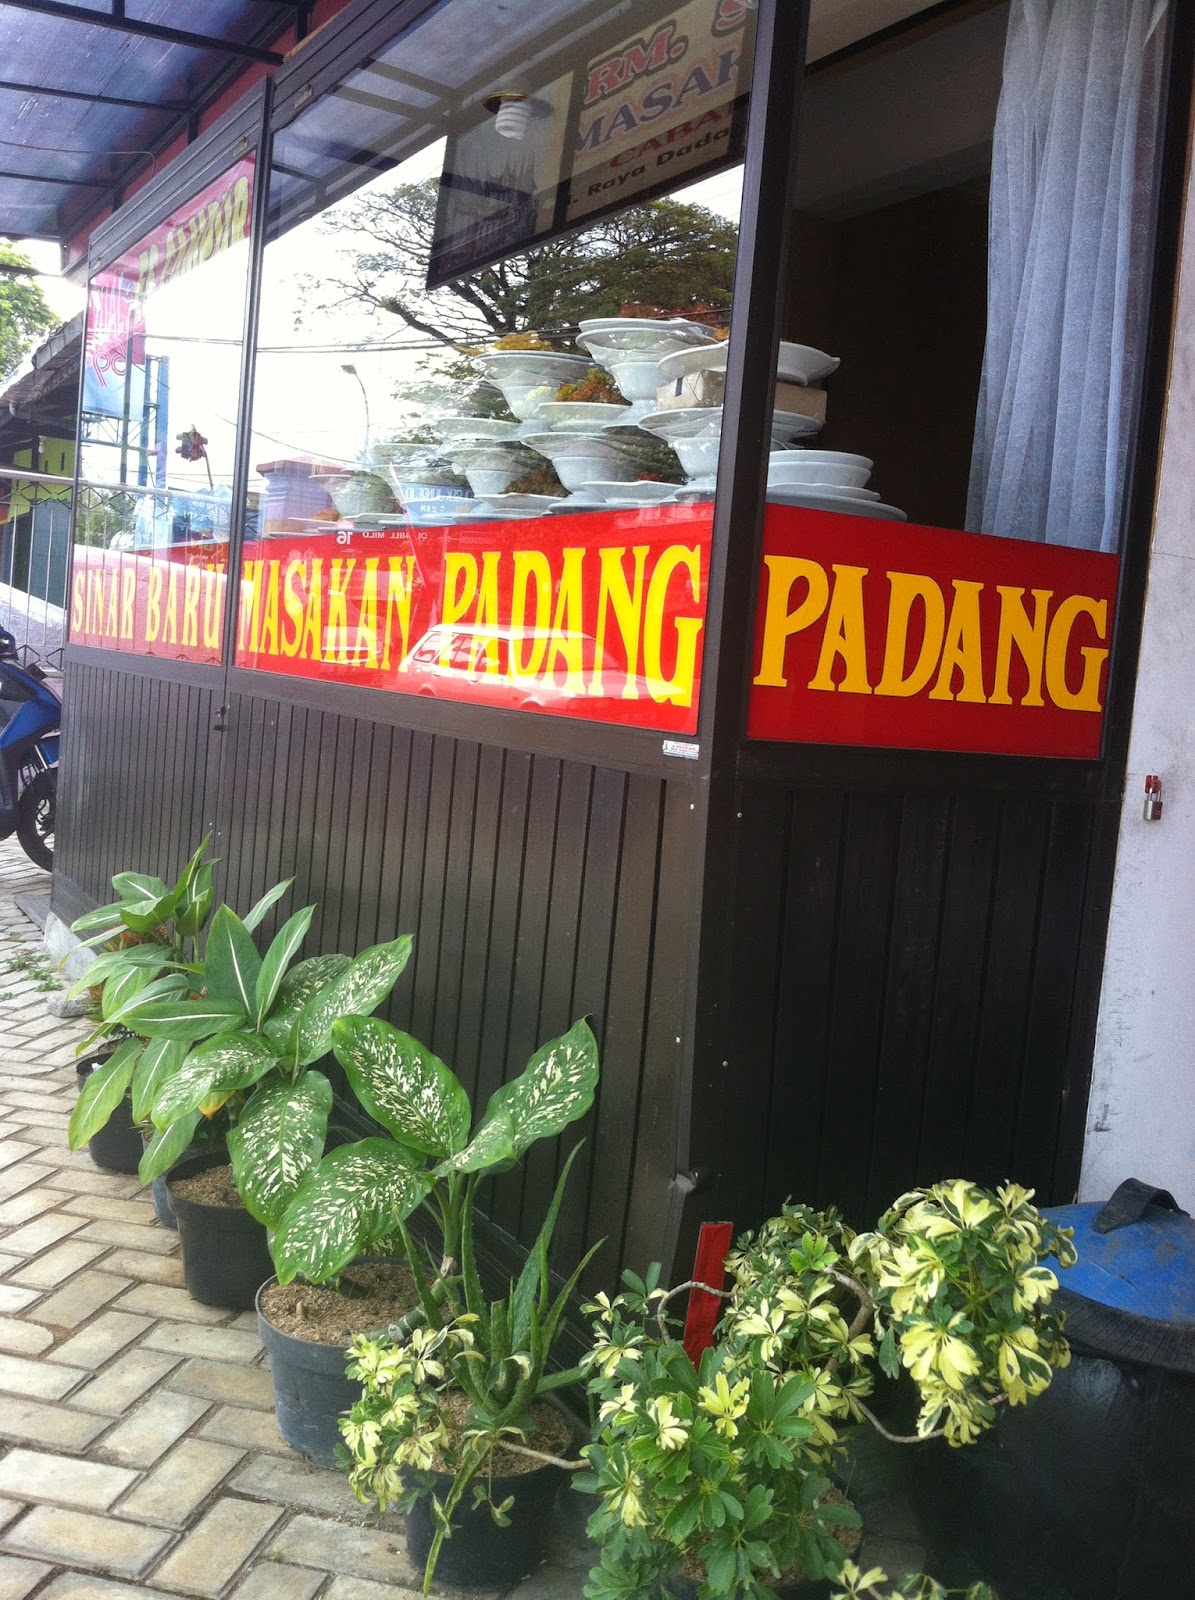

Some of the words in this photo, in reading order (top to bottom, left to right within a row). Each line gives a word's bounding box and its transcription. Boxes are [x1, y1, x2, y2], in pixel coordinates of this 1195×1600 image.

[583, 22, 688, 106] RM.
[587, 164, 646, 196] Raya
[656, 127, 730, 166] Dada
[72, 566, 135, 639] SINAR
[145, 562, 224, 650] BARU
[237, 555, 416, 673] MASAKAN
[440, 544, 703, 708] PADANG
[753, 554, 1109, 713] PADANG
